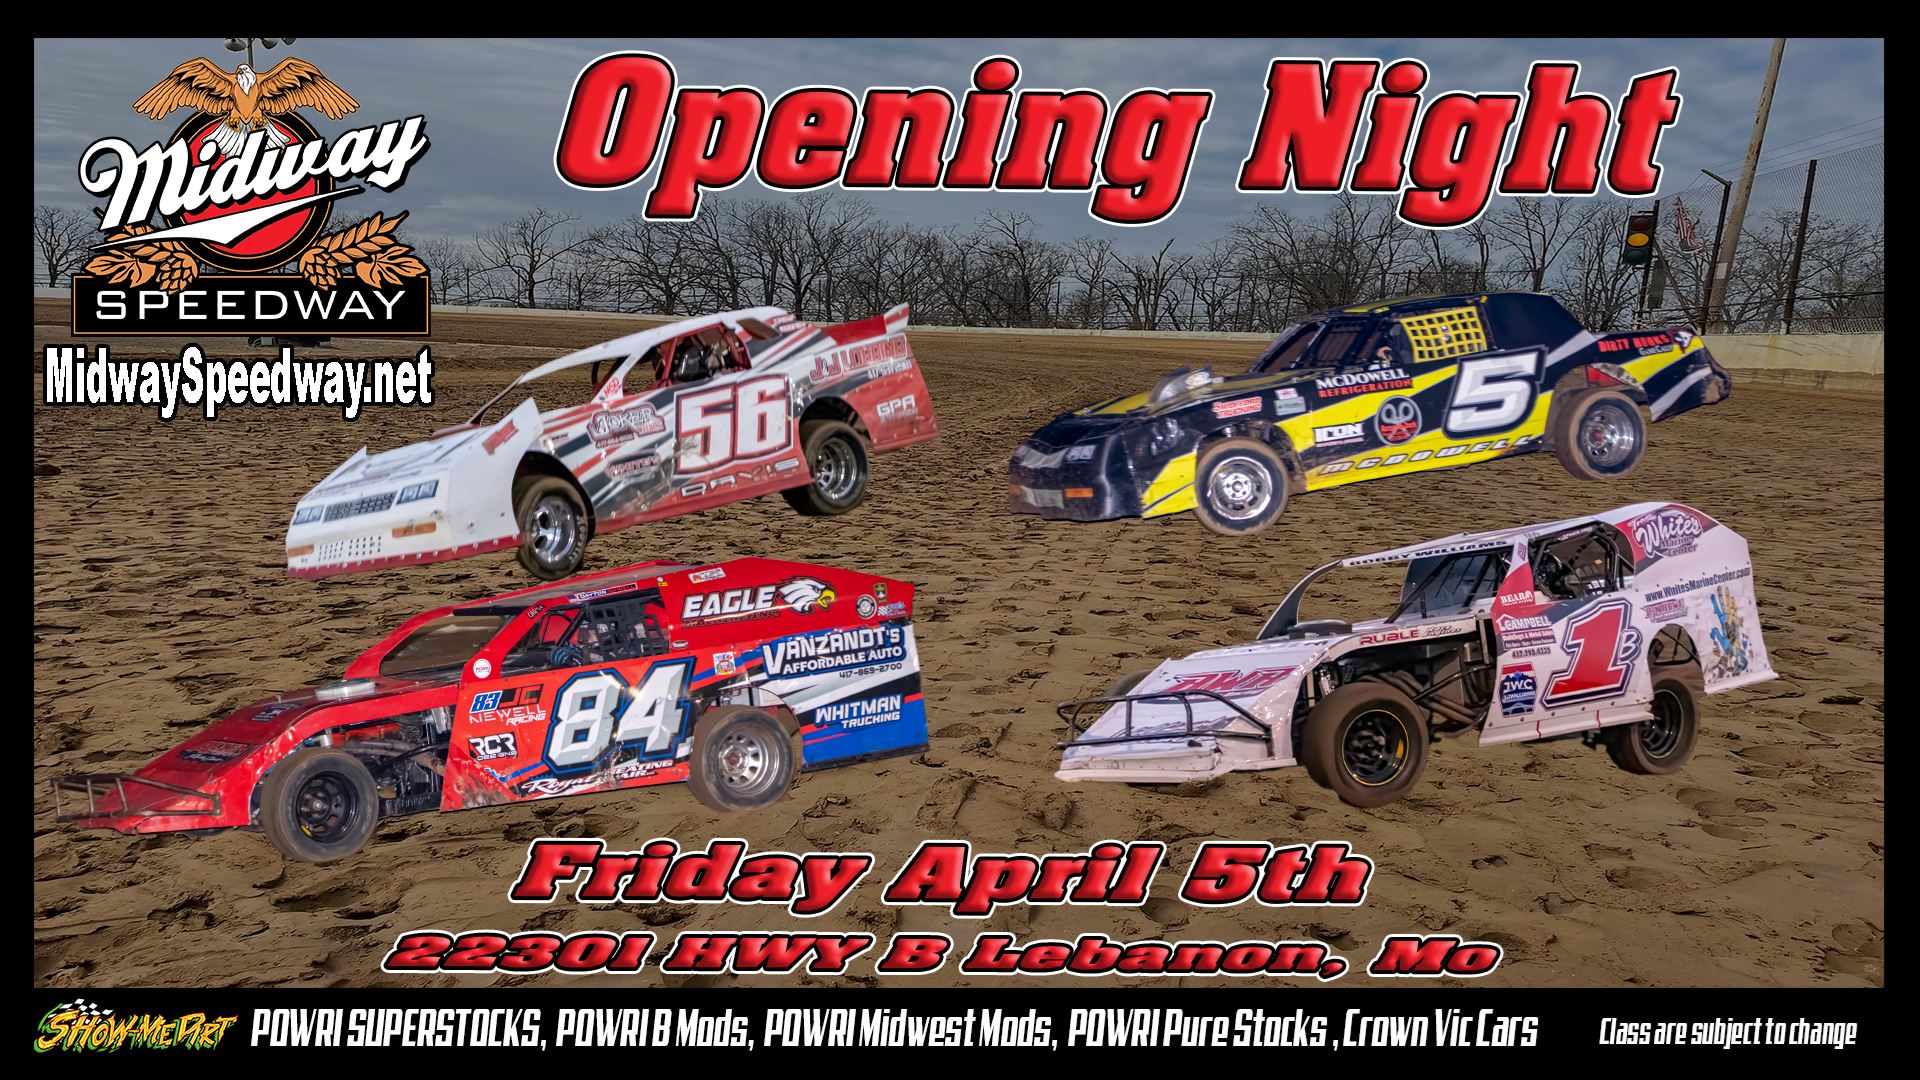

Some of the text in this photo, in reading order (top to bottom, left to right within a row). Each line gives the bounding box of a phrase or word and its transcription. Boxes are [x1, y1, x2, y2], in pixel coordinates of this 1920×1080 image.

[1598, 338, 1630, 352] DIRTY
[1318, 379, 1412, 398] REFRIGERATION
[1444, 345, 1547, 440] 5
[876, 394, 916, 417] GPA
[675, 371, 793, 474] 56
[1313, 423, 1365, 443] ICON
[680, 457, 800, 497] DAVIS
[1349, 540, 1508, 566] BOBBY WILLIAMS
[1644, 566, 1751, 603] www.WhitesMarineCenter.com
[682, 584, 777, 620] EAGLE
[1500, 592, 1525, 604] BEAR
[1504, 615, 1553, 631] CAMPBELL
[1360, 629, 1420, 646] RUBLE
[762, 627, 901, 675] VANZANDT'S
[783, 646, 903, 675] AFFORDABLE AUTO
[839, 663, 903, 678] 417-869-2700
[1503, 678, 1534, 694] JWC
[469, 689, 503, 714] 83
[816, 695, 901, 724] WHITMAN
[469, 704, 547, 725] NEWELL
[505, 712, 547, 726] RACING
[545, 658, 693, 772] 84
[842, 711, 901, 729] TRUCKING
[468, 733, 516, 758] RCR
